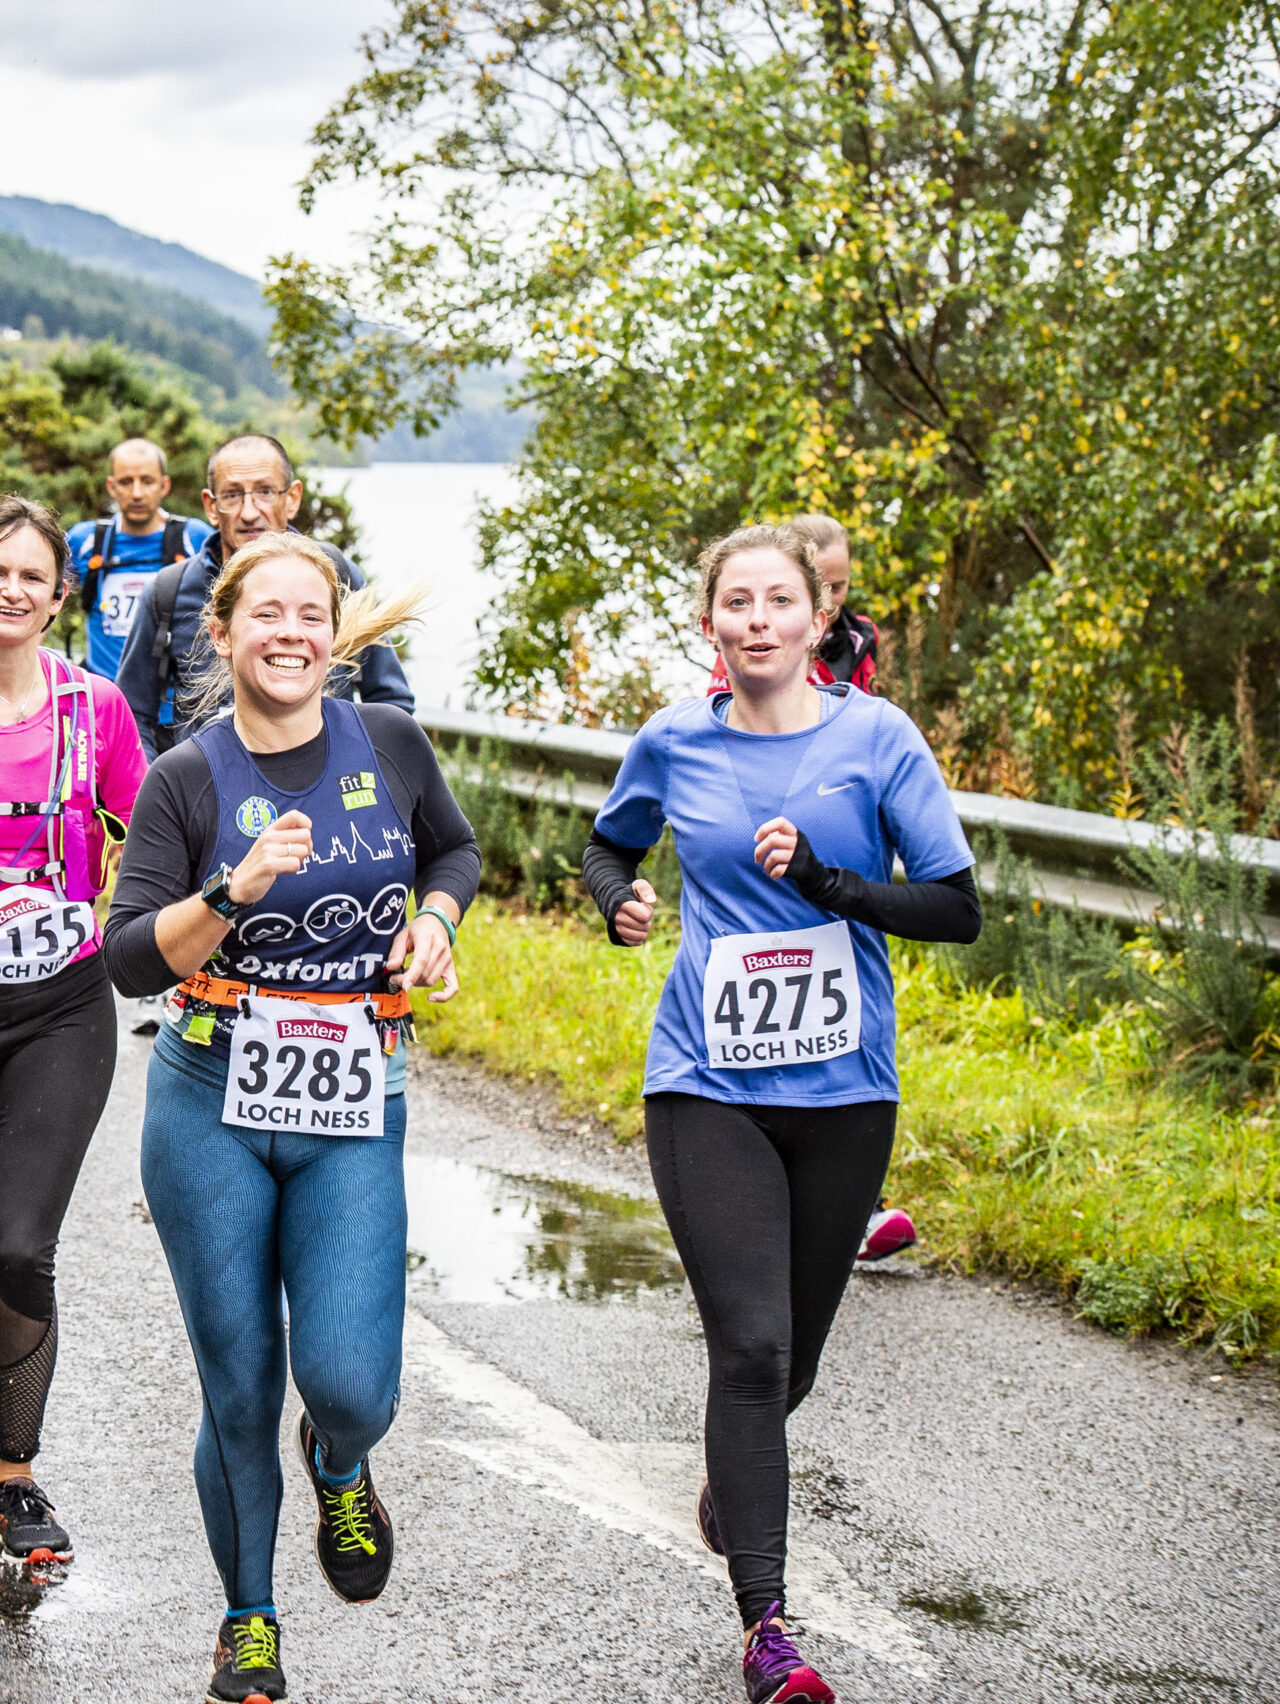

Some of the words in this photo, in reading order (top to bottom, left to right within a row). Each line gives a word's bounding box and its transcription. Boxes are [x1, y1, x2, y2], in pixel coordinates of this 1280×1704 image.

[109, 595, 136, 620] 37
[339, 775, 361, 793] fit
[361, 773, 374, 788] 2
[344, 790, 374, 807] run
[236, 953, 385, 982] OxfordT
[744, 951, 811, 973] Baxters
[714, 968, 848, 1036] 4275
[280, 1020, 345, 1042] Baxters
[720, 1041, 785, 1063] LOCH
[795, 1029, 848, 1057] NESS
[237, 1040, 372, 1104] 3285
[236, 1100, 302, 1126] LOCH
[310, 1109, 370, 1129] NESS
